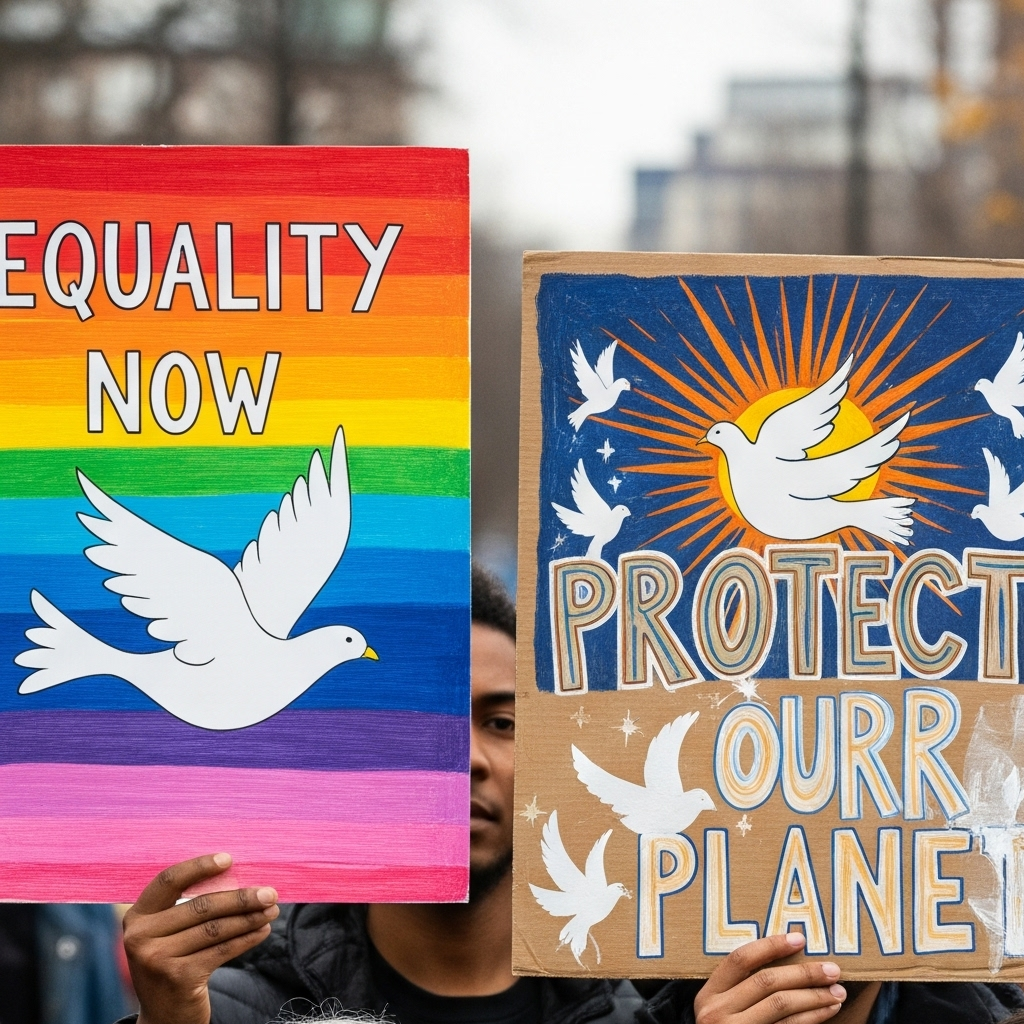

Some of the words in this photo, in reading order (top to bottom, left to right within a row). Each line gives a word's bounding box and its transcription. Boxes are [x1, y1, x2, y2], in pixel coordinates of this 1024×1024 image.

[0, 220, 403, 321] EQUALITY
[87, 350, 281, 435] NOW
[713, 687, 971, 821] OURR
